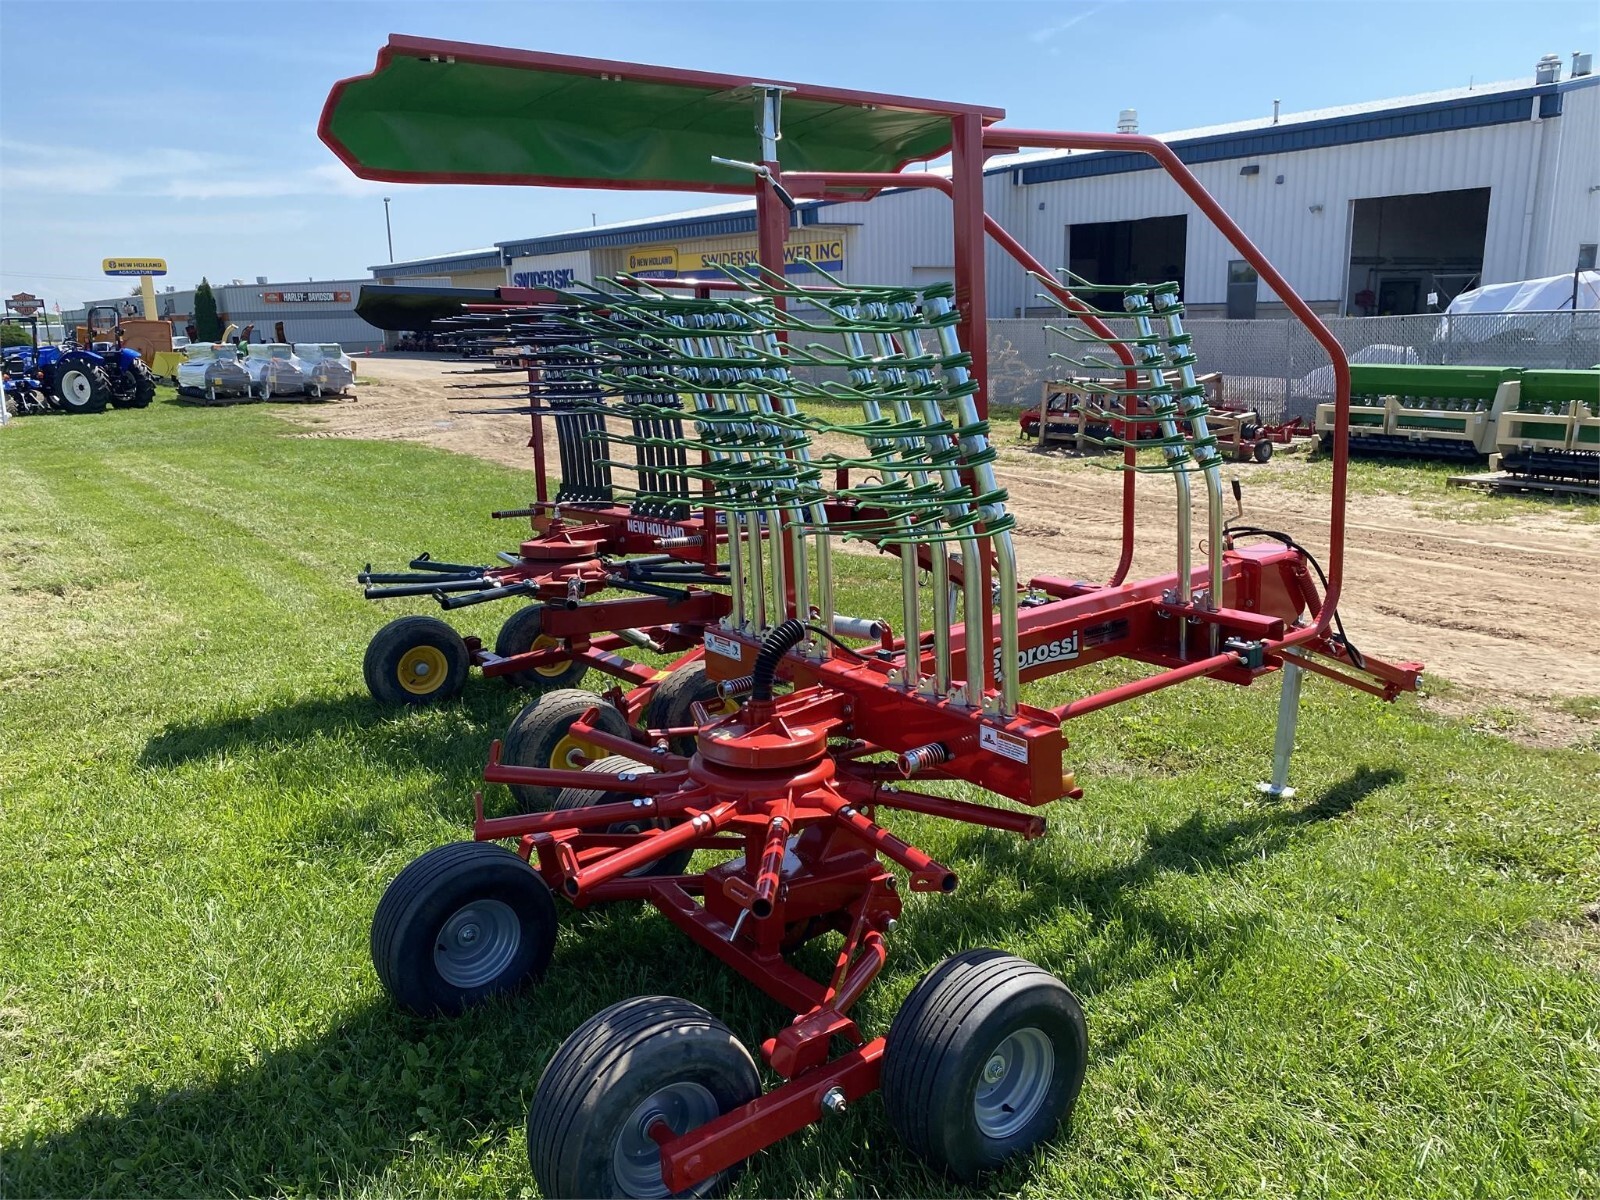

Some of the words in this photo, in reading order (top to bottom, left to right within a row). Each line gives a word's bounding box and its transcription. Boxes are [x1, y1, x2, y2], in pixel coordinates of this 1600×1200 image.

[637, 258, 648, 267] NEW
[649, 255, 673, 266] HOLLAND
[701, 250, 759, 268] SWIDERSK
[816, 242, 840, 260] INC
[513, 268, 575, 289] SWIDERSKI
[627, 519, 645, 534] NEW
[646, 522, 685, 538] HOLLAND
